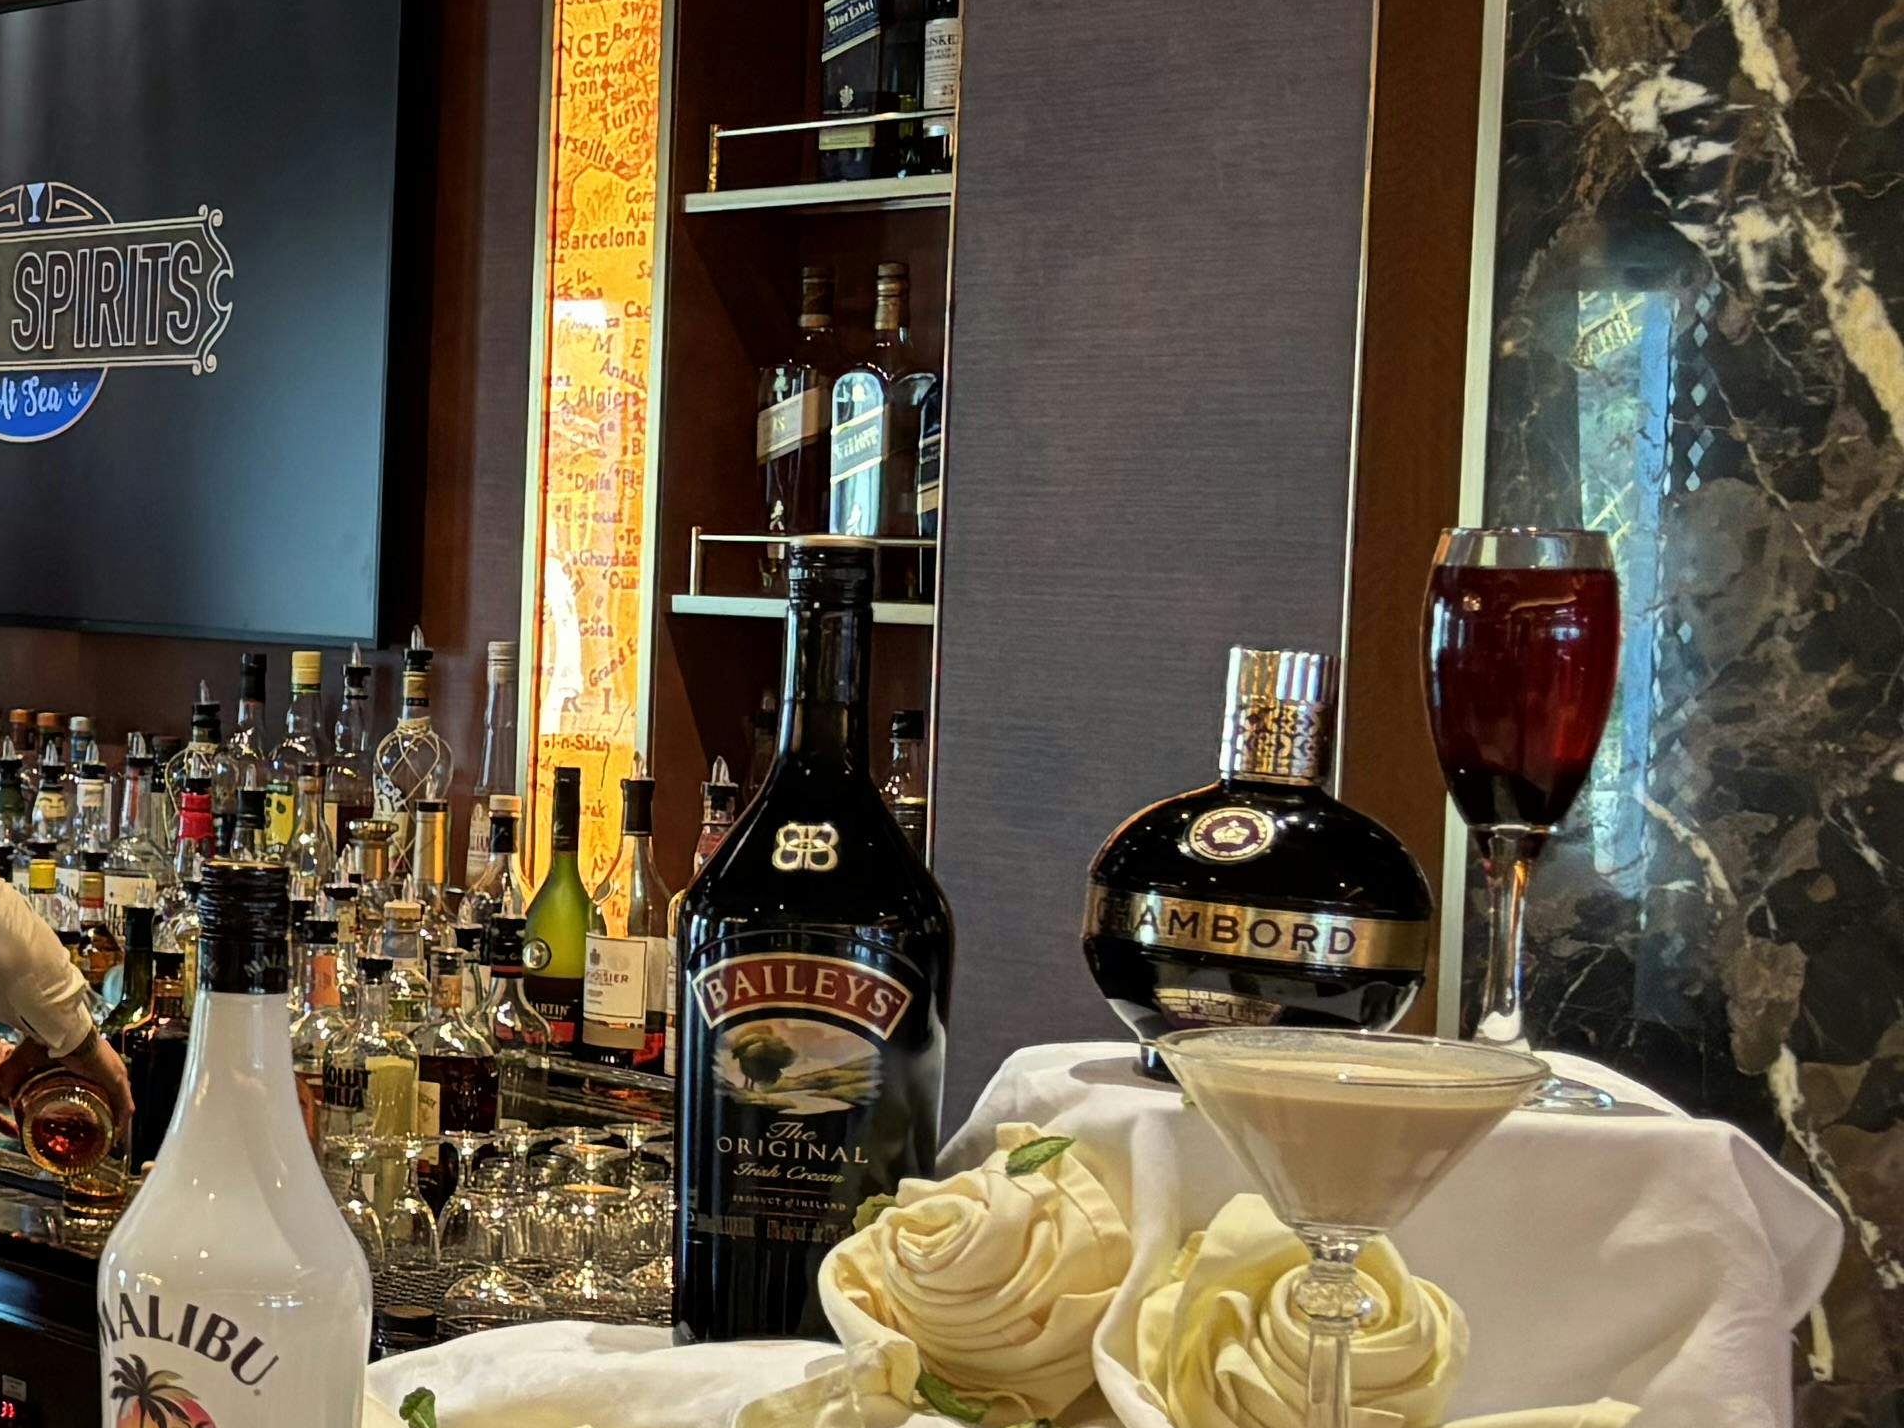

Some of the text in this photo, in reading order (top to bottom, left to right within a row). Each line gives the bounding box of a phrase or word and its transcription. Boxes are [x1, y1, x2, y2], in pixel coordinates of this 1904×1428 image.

[559, 225, 647, 251] Barcelona
[11, 239, 204, 352] SPIRITS
[22, 375, 63, 417] Sea
[706, 964, 894, 1018] BAILEYS
[765, 1121, 818, 1141] The
[716, 1136, 869, 1164] ORIGINAL
[733, 1162, 845, 1183] Irish Cream
